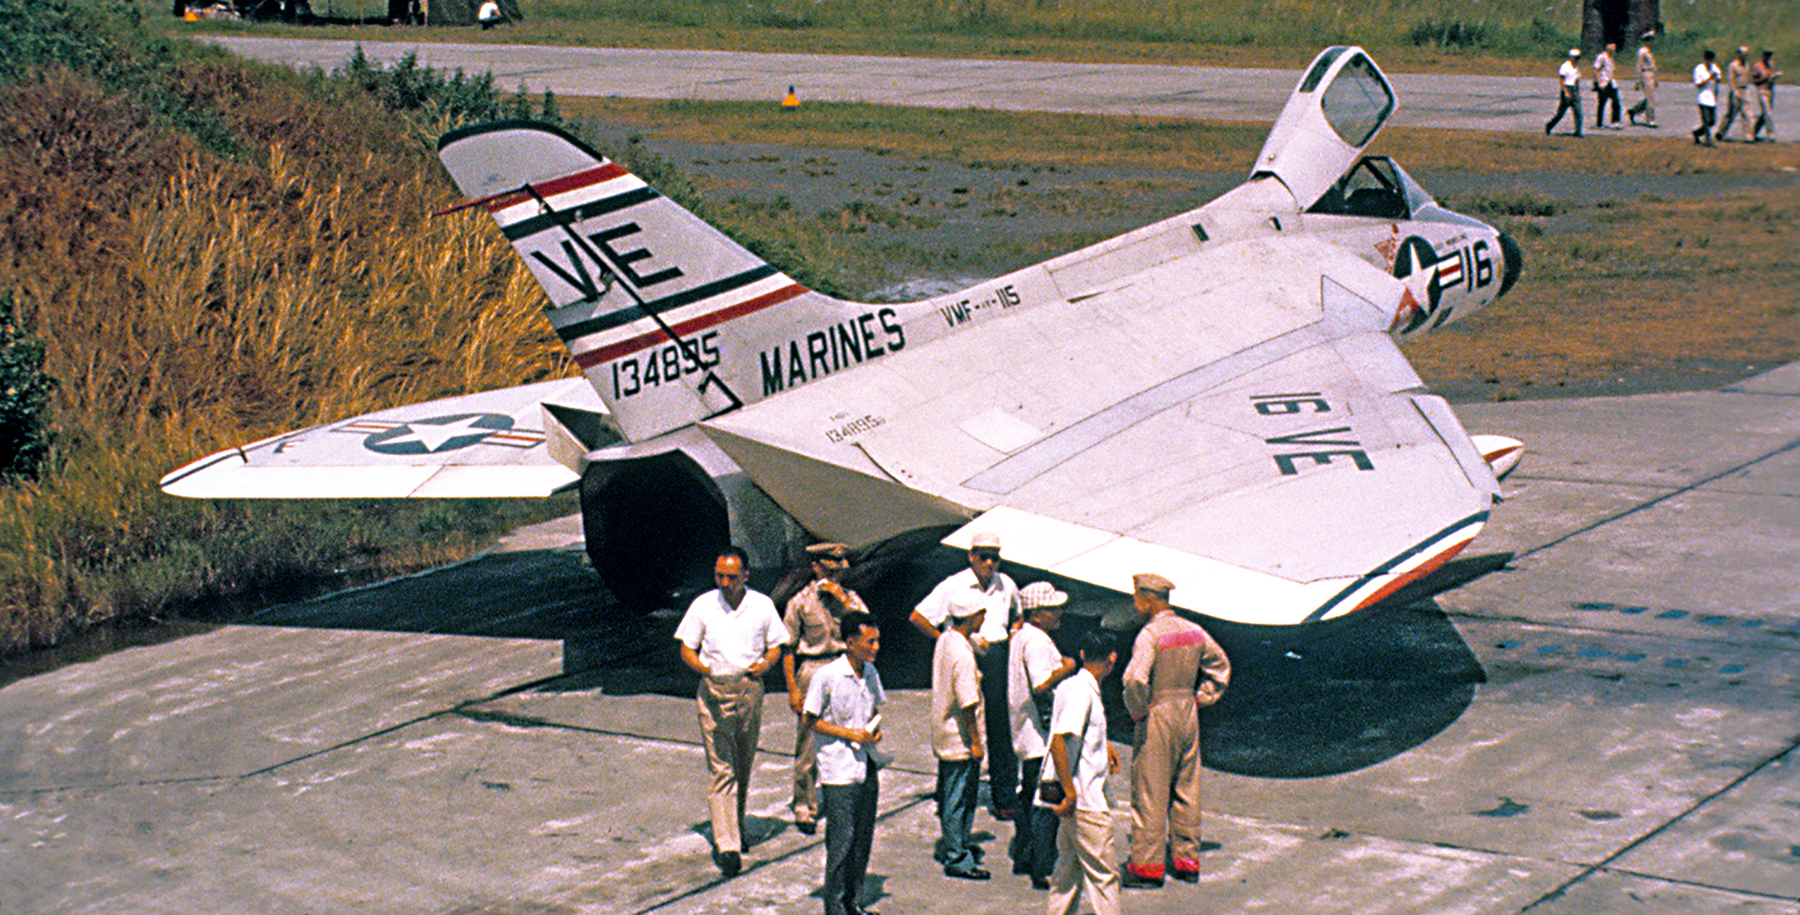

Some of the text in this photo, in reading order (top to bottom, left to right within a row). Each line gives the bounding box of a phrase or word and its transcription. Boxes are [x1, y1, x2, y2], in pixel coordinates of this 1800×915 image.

[530, 222, 684, 303] VE
[1463, 239, 1493, 293] 16
[612, 331, 719, 399] 134895
[760, 308, 906, 396] MARINES
[1249, 392, 1375, 475] 16 VE
